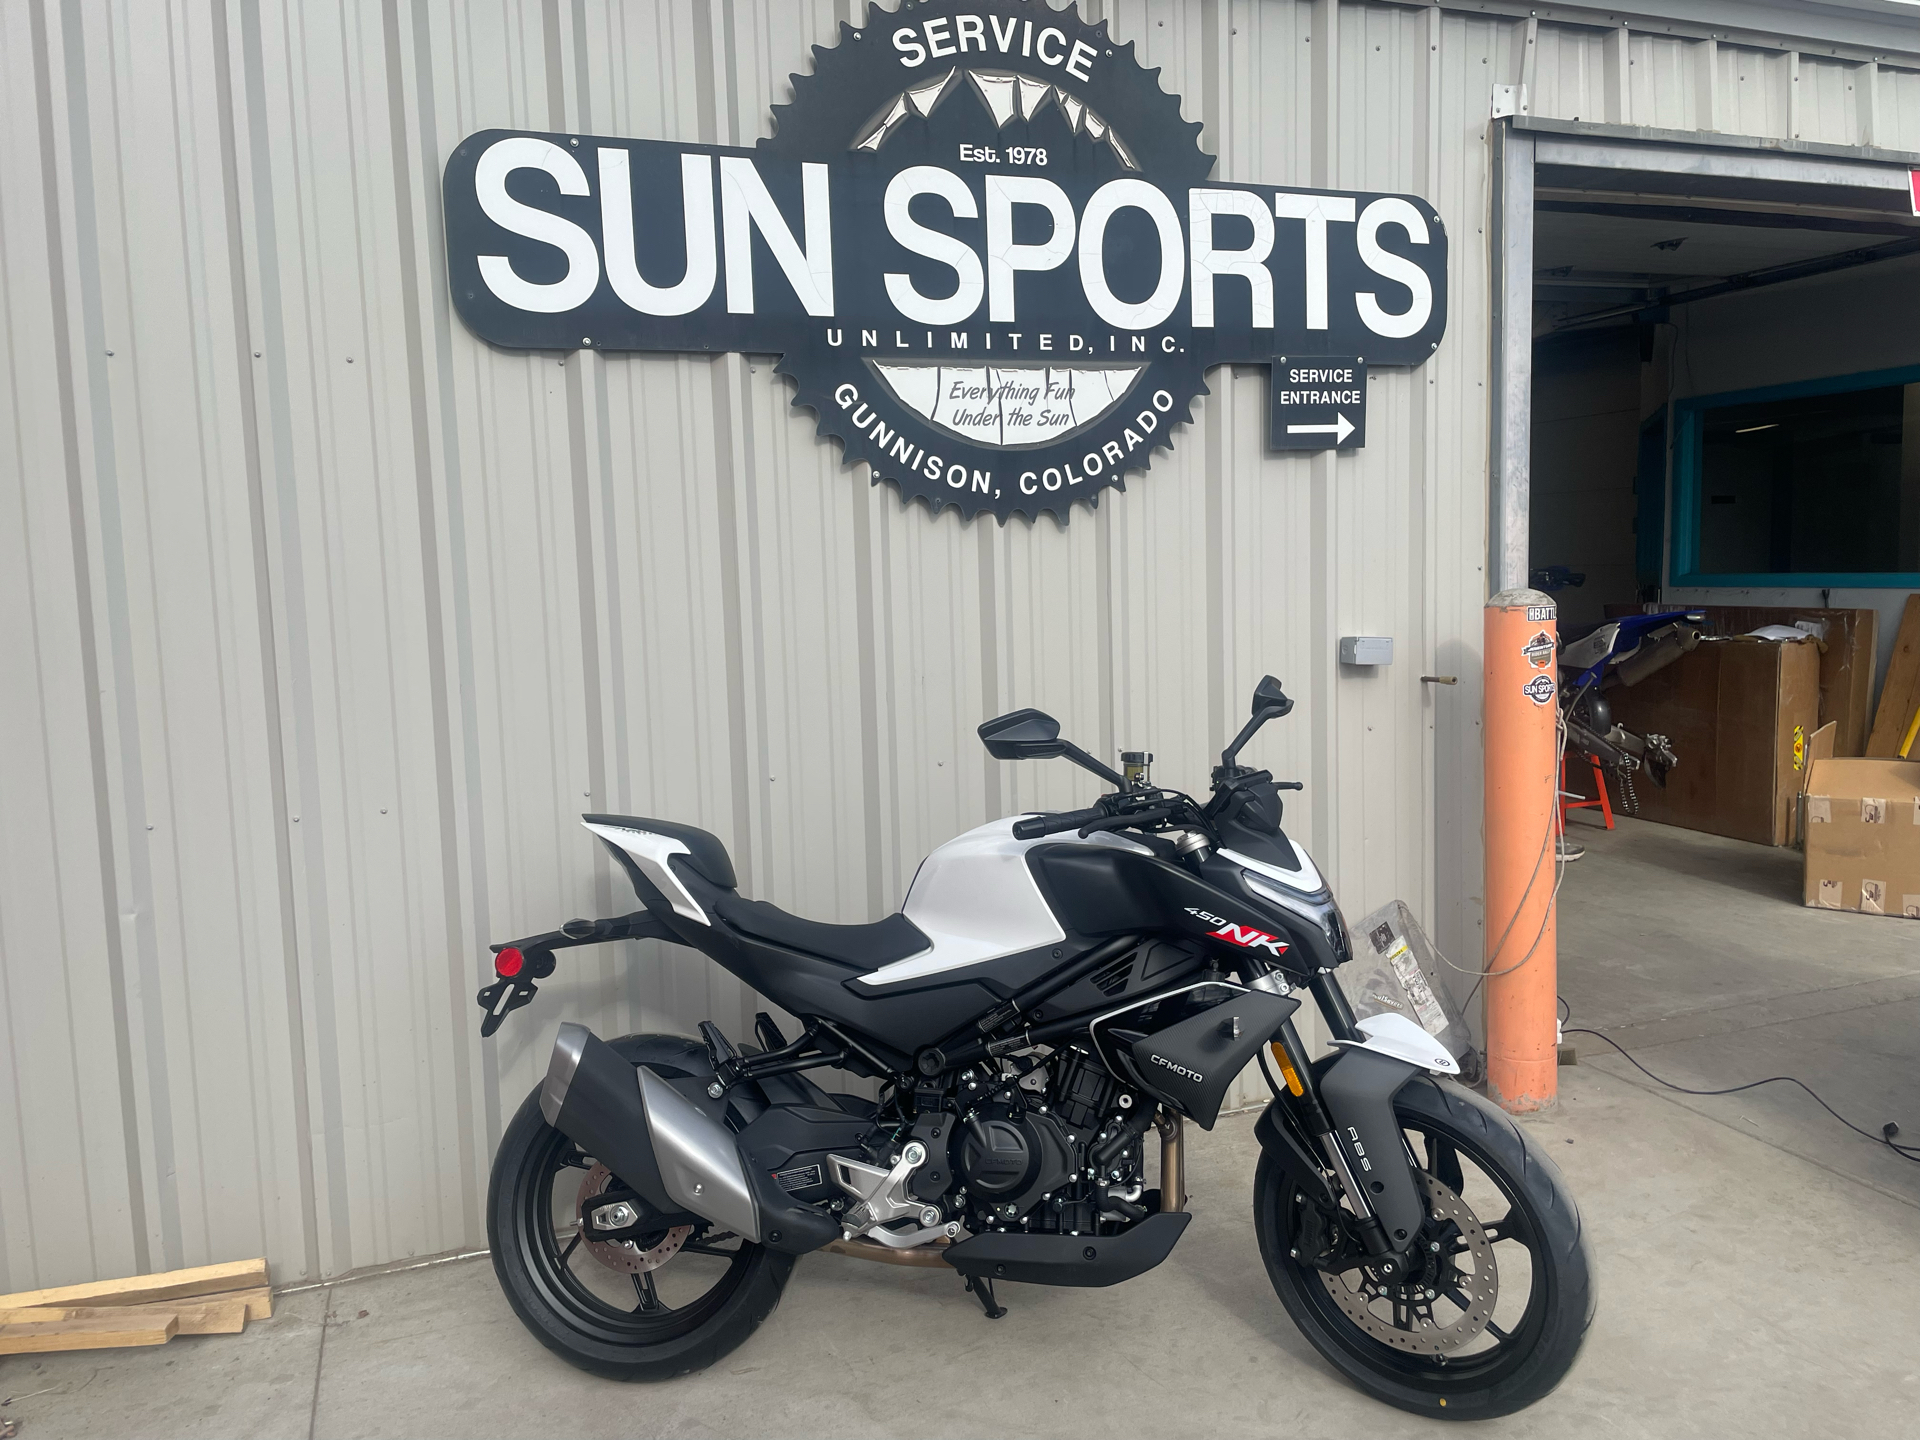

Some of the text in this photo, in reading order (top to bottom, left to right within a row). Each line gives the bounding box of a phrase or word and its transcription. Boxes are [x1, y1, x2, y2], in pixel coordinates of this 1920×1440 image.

[892, 14, 1098, 83] SERVICE
[959, 143, 1048, 166] Est. 1978
[474, 137, 1433, 339] SUN SPORTS
[827, 328, 1185, 355] UNLIMITED, INC.
[1289, 368, 1353, 383] SERVICE
[949, 380, 1076, 406] Everything Fun
[1280, 390, 1361, 405] ENTRANCE
[952, 406, 1070, 426] Under the Sun
[834, 383, 1174, 499] GUNNISON, COLORADO
[1524, 685, 1538, 694] SUN
[1183, 907, 1290, 957] 450 NK
[1150, 1054, 1203, 1083] CFMOTO
[1347, 1126, 1372, 1172] ABS
